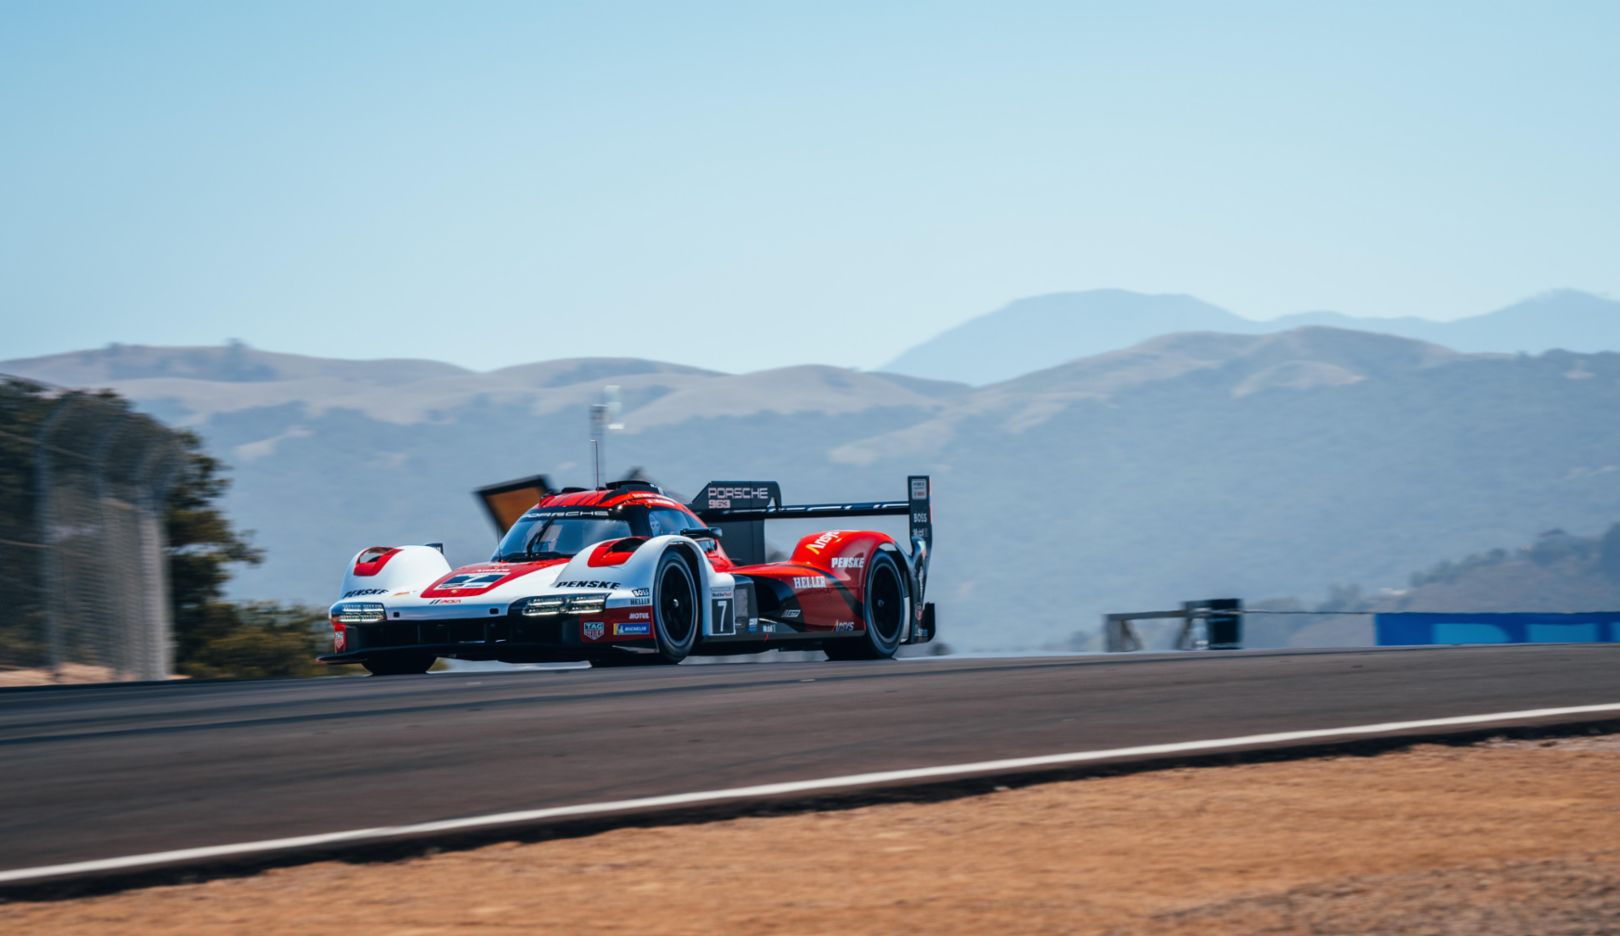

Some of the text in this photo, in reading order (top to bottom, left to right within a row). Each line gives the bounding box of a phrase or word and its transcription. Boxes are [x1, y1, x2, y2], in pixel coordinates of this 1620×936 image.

[708, 487, 768, 499] PORSCHE
[708, 499, 731, 509] 963
[831, 557, 865, 568] PENSKE
[555, 580, 621, 589] PENSKE
[793, 576, 826, 588] HELLER
[717, 600, 727, 632] 7
